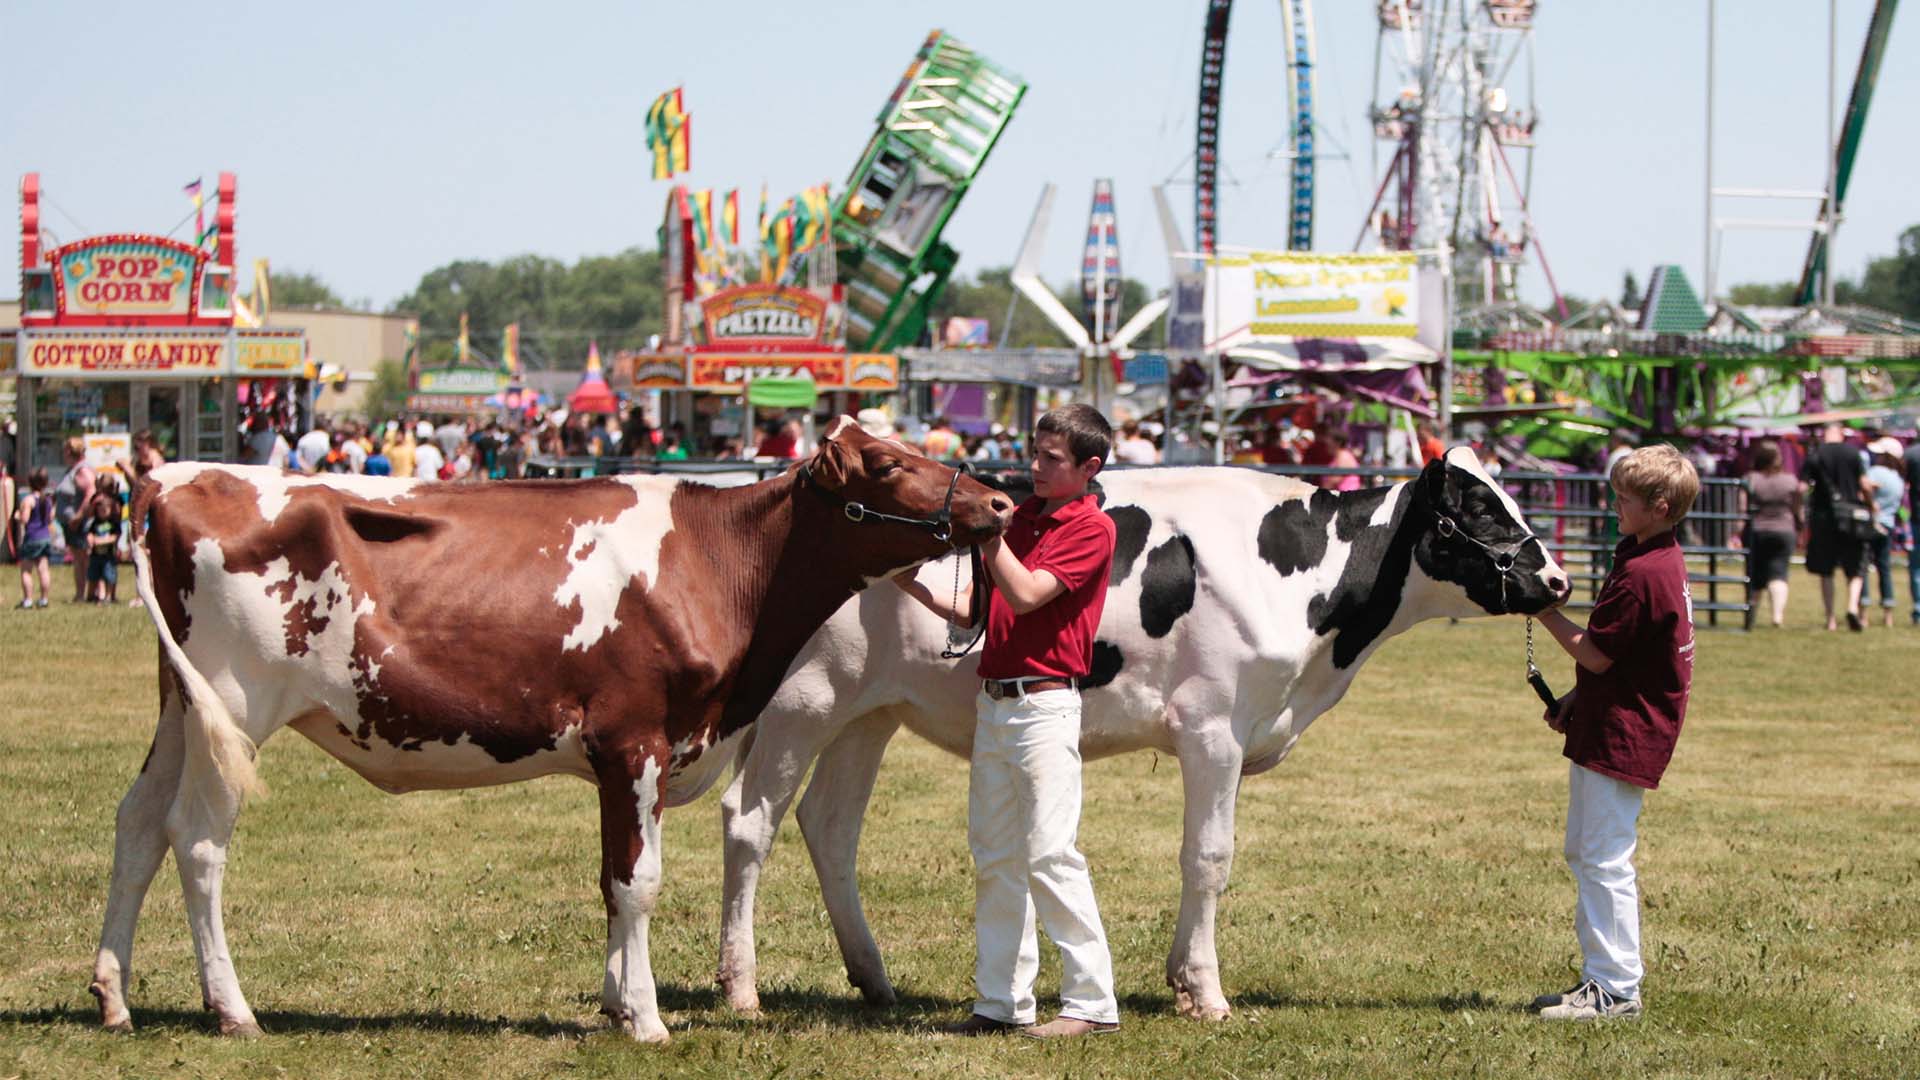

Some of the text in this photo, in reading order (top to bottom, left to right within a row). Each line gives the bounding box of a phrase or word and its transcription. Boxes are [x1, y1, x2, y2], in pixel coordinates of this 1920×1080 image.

[96, 258, 159, 279] POP
[81, 281, 174, 302] CORN
[718, 308, 812, 335] PRETZELS
[33, 342, 125, 368] COTTON
[133, 342, 222, 367] CANDY
[724, 366, 814, 382] PIZZA
